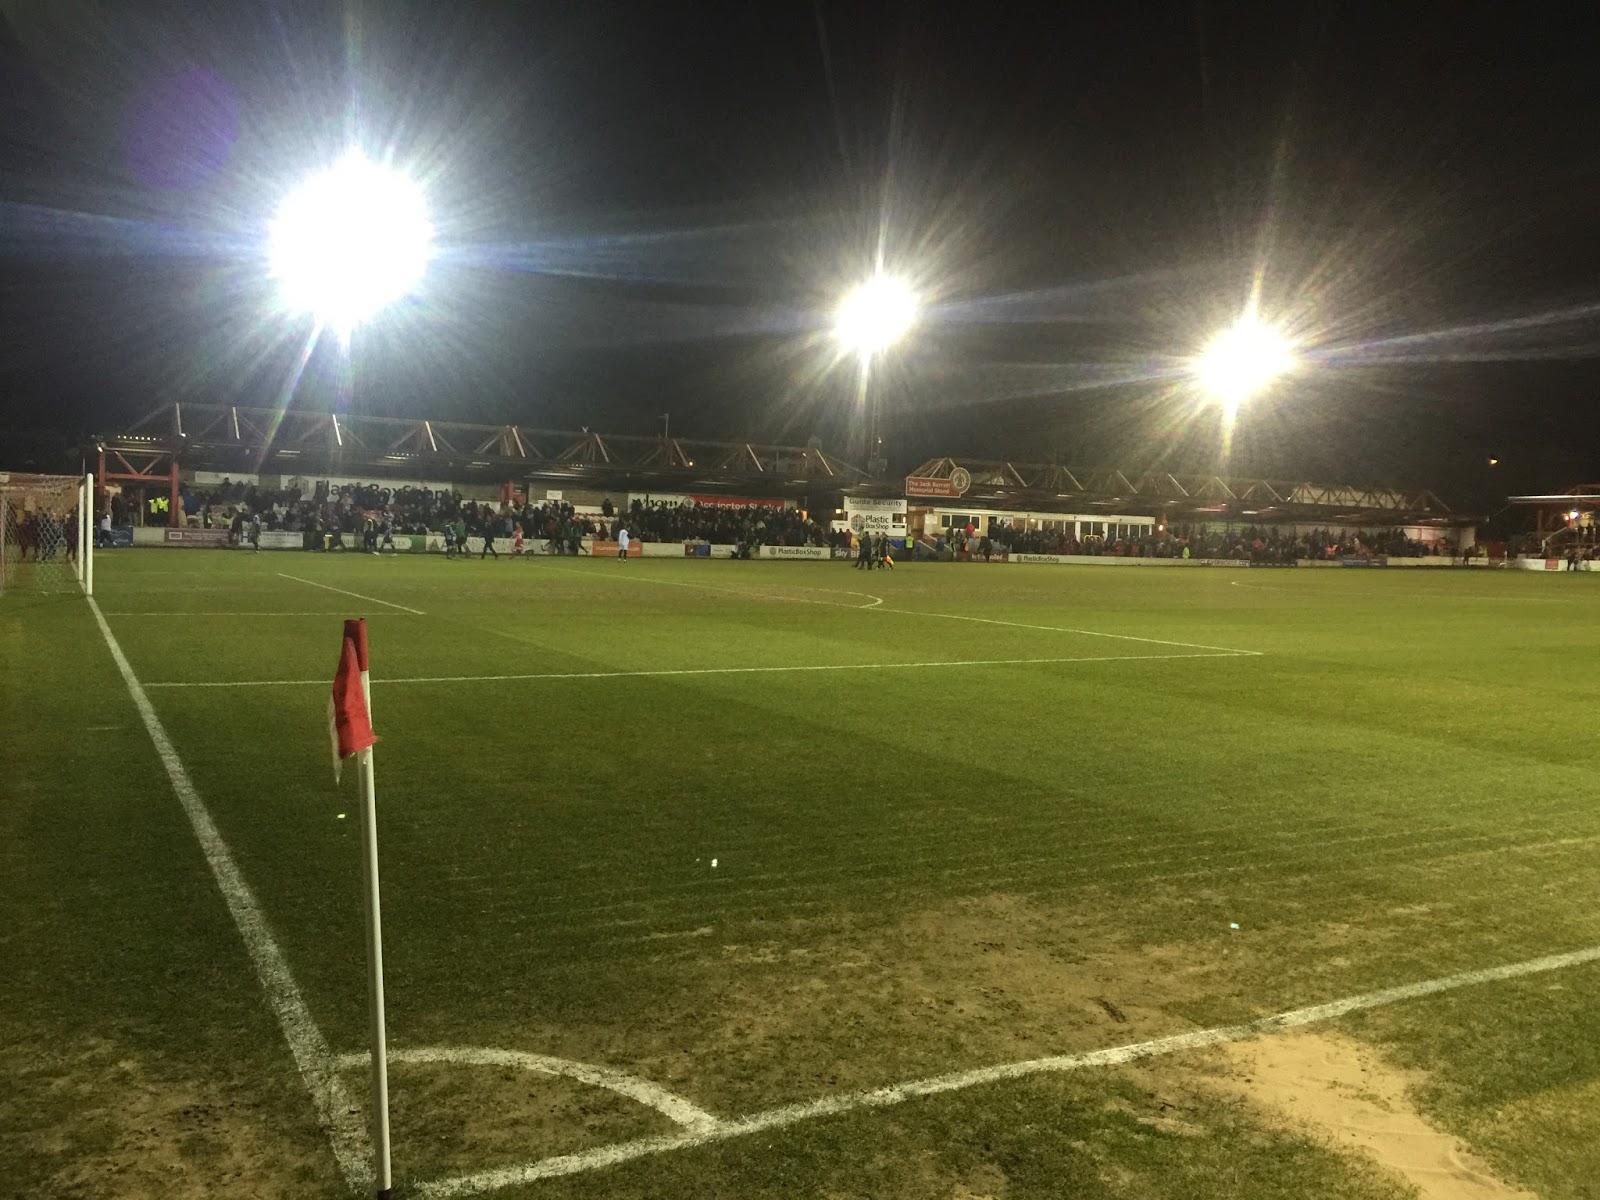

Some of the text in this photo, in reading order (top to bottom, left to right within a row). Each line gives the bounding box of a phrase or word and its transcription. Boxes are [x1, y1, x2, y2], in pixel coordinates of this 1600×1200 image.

[872, 499, 902, 507] Security
[865, 514, 890, 524] Plastic
[778, 548, 822, 556] PlasticBoxShop
[835, 549, 848, 558] sky
